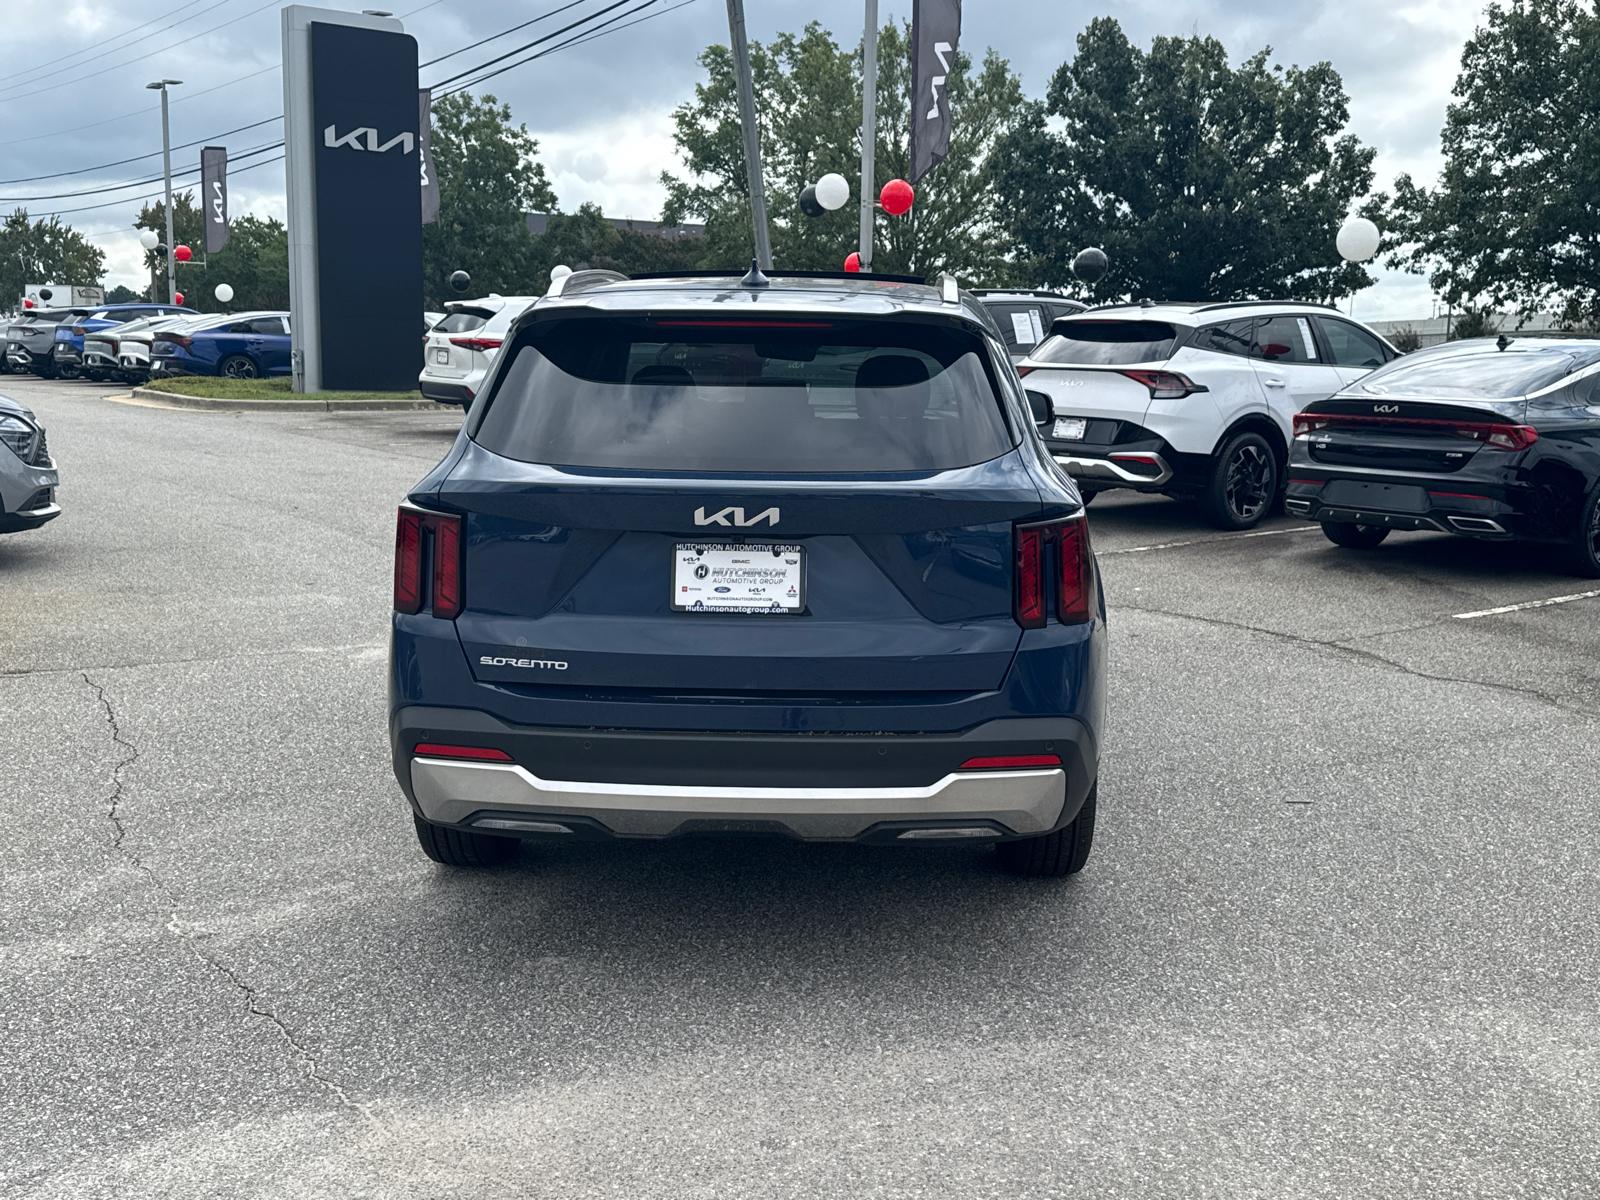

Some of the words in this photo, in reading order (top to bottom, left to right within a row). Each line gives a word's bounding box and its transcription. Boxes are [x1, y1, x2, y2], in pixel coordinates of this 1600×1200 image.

[324, 124, 414, 155] KIA
[213, 182, 224, 223] KIA
[1060, 379, 1084, 387] KIA
[1374, 404, 1399, 413] KIA
[694, 506, 780, 527] KIA
[676, 543, 724, 551] HUTCHINSON
[774, 545, 801, 553] GROUP
[711, 567, 788, 578] HUTCHINSON
[685, 604, 789, 614] Hutchinsonautogroup.com
[480, 656, 569, 670] SORENTO
